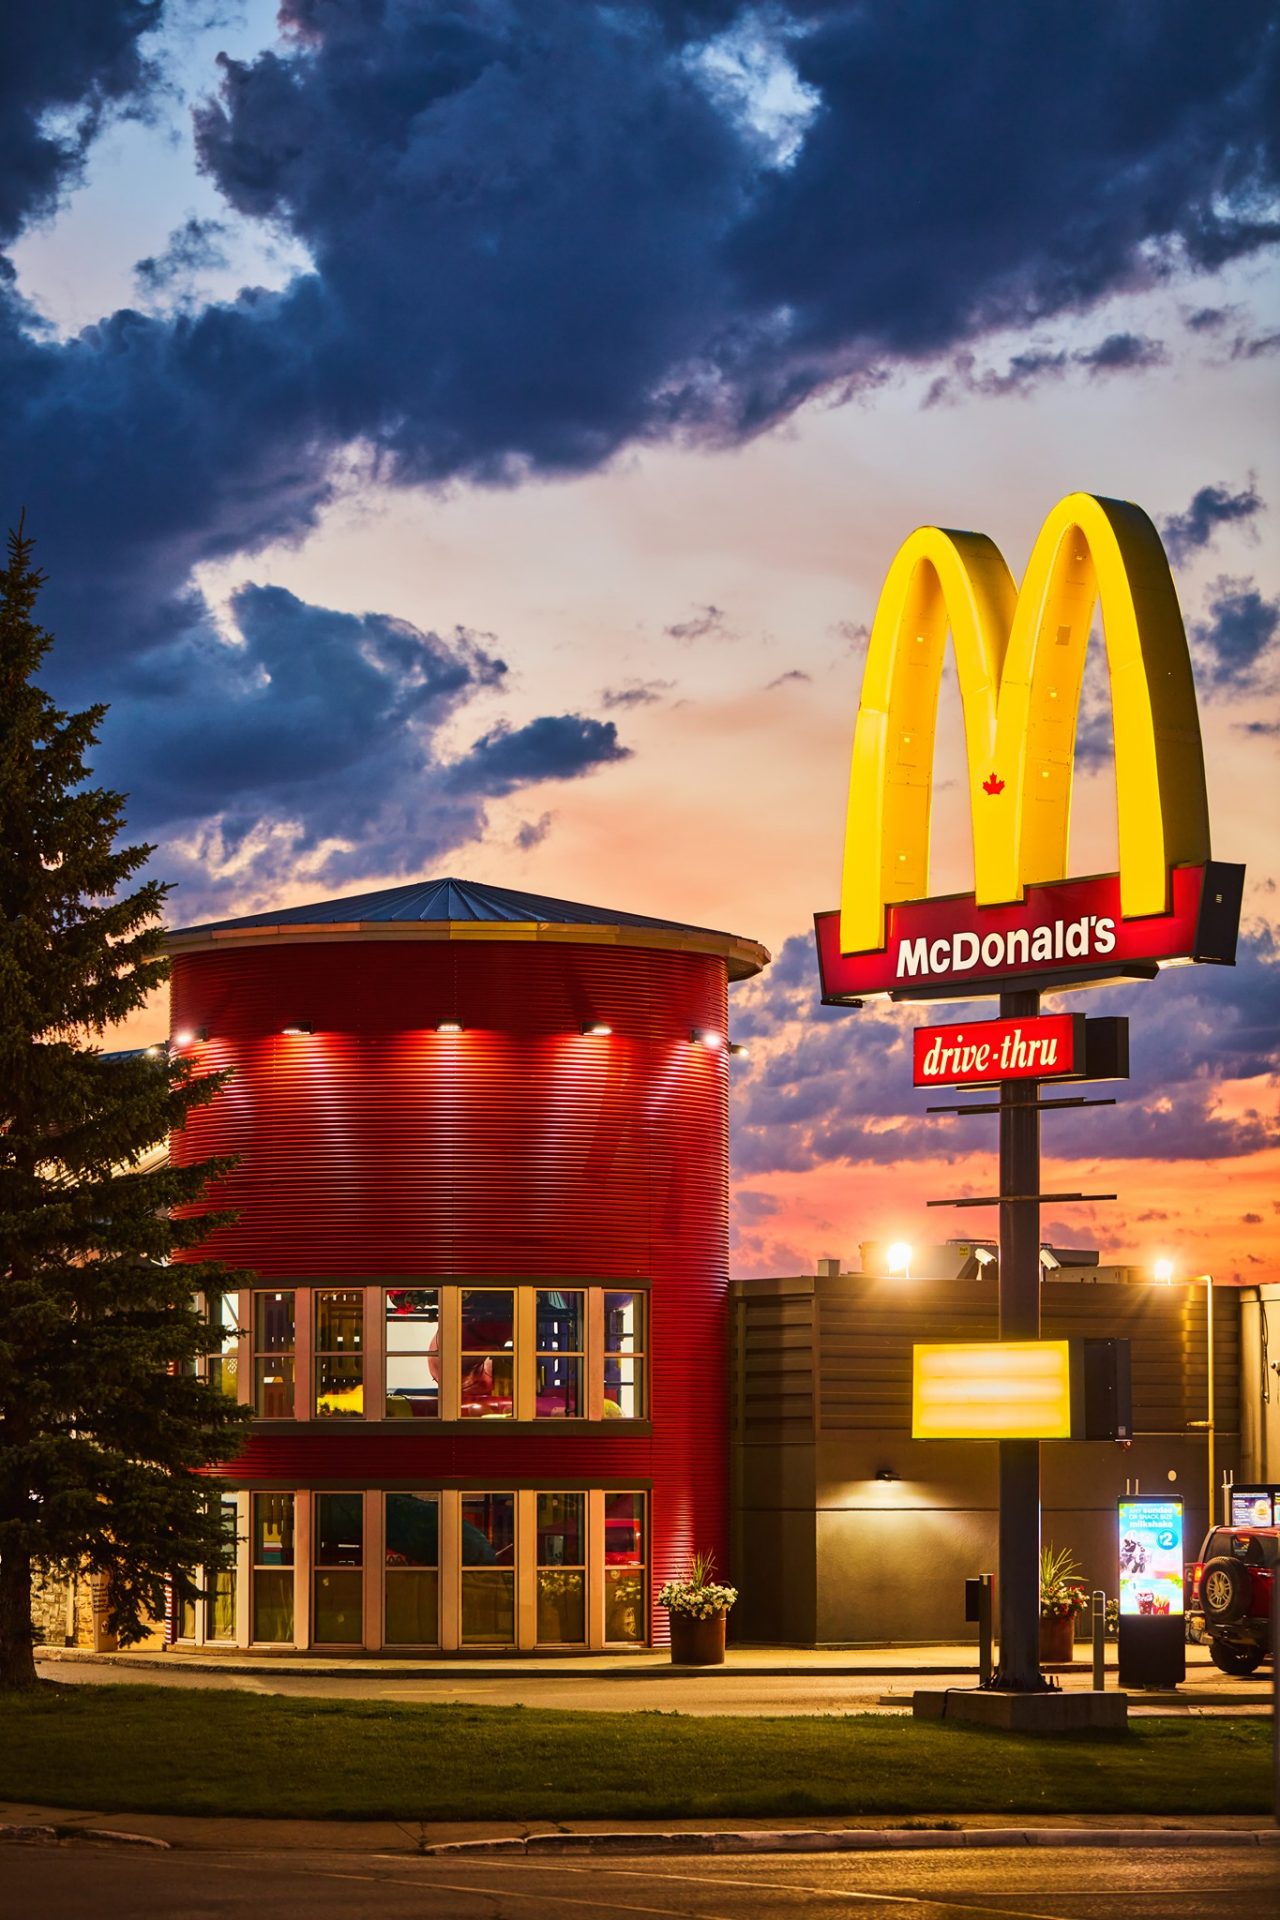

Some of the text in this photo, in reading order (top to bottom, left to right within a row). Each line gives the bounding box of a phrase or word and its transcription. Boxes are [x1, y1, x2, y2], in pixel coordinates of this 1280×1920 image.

[896, 916, 1116, 978] McDonald's
[923, 1029, 1058, 1076] drive-thru
[1129, 1520, 1173, 1528] milkshake
